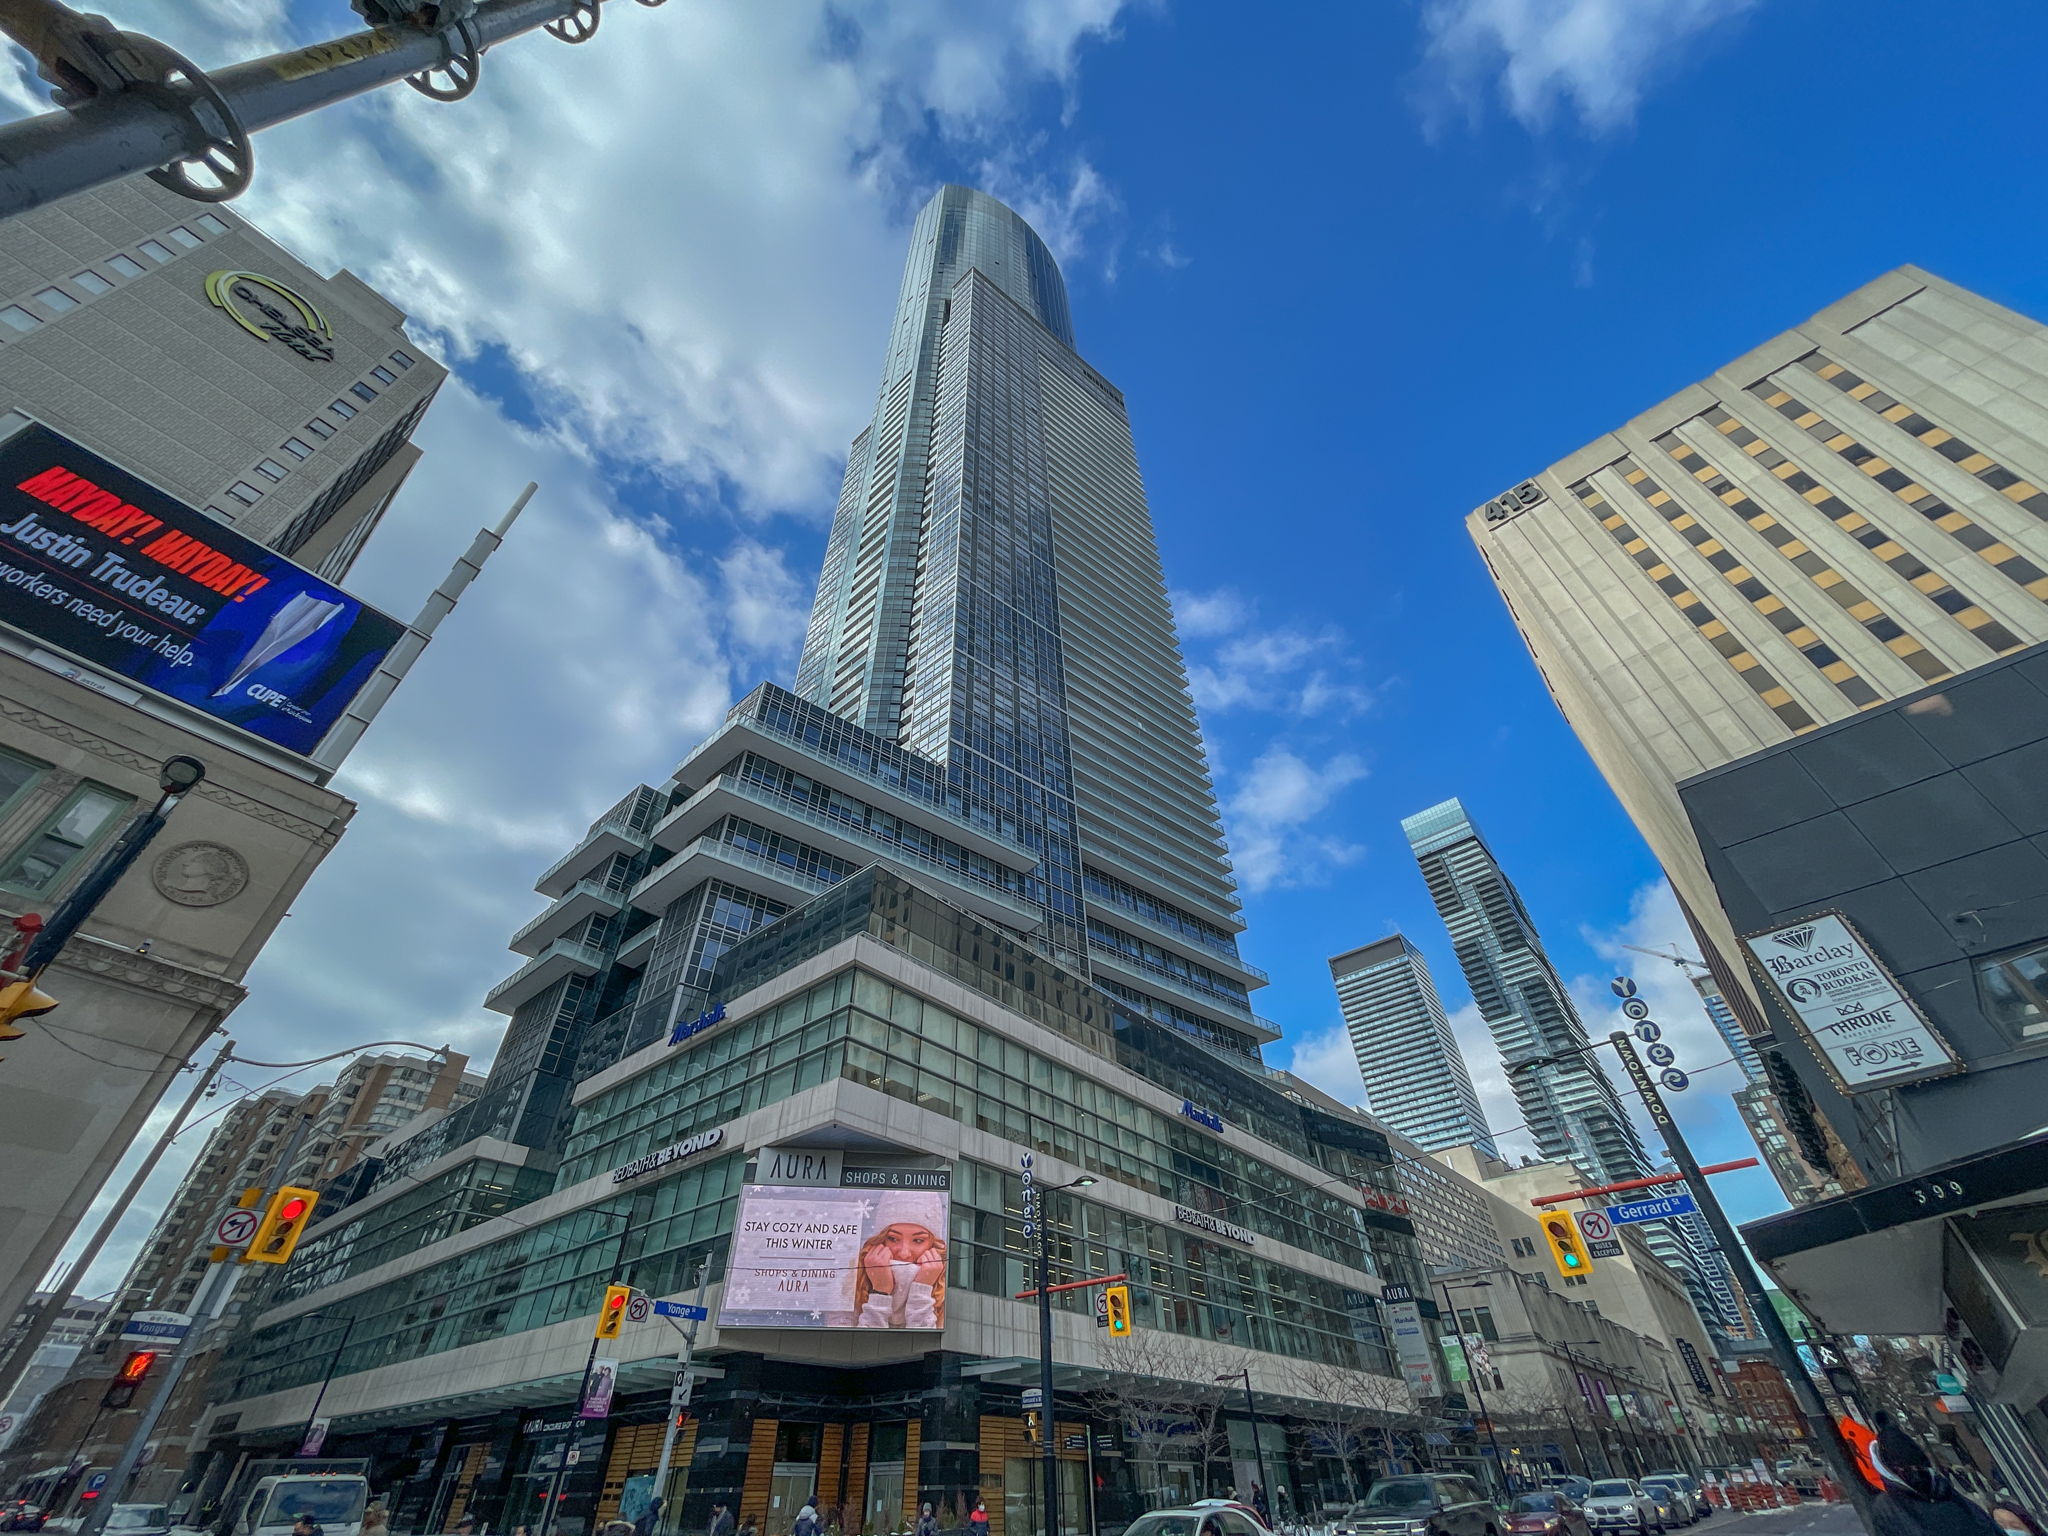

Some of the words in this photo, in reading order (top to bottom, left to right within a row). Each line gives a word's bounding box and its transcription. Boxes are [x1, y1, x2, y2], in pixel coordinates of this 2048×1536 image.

[233, 286, 335, 361] CHELSEA
[259, 321, 331, 362] Hotel
[1484, 480, 1544, 522] 415
[15, 465, 164, 545] MAYDAY!
[139, 529, 270, 604] MAYDAY!
[1, 512, 94, 569] Justin
[90, 551, 206, 626] Trudeau:
[0, 561, 70, 606] workers
[65, 596, 123, 628] need
[106, 621, 158, 647] your
[152, 633, 195, 668] help.
[246, 683, 287, 708] CUPE
[1765, 942, 1855, 979] Barclay
[1814, 960, 1870, 982] TORONTO
[1821, 969, 1878, 991] BUDOKAN
[1610, 976, 1690, 1092] Yonge
[1829, 1010, 1896, 1036] THRONE
[1844, 1037, 1922, 1067] FONE
[1615, 1038, 1669, 1125] DOWNTOWN
[1180, 1099, 1225, 1134] Marshalls
[656, 1128, 723, 1166] BEYOND
[769, 1153, 828, 1181] AURA
[845, 1171, 886, 1185] SHOPS
[891, 1173, 899, 1185] &
[904, 1174, 946, 1187] DINING
[1021, 1152, 1035, 1239] Yonge
[1914, 1180, 1962, 1204] 399
[1618, 1199, 1672, 1219] Gerrard
[1671, 1198, 1680, 1206] St
[744, 1221, 770, 1232] STAY
[772, 1222, 803, 1233] COZY
[804, 1223, 830, 1234] AND
[832, 1224, 858, 1235] SAFE
[1215, 1219, 1257, 1245] BEYOND
[766, 1238, 789, 1249] THIS
[792, 1239, 833, 1250] WINTER
[1593, 1248, 1621, 1257] EXCEPTED
[1594, 1241, 1613, 1250] BUSES
[754, 1269, 788, 1278] SHOPS
[792, 1269, 798, 1278] &
[801, 1269, 836, 1279] DINING
[777, 1280, 810, 1293] AURA
[1386, 1286, 1410, 1300] AURA
[667, 1303, 691, 1318] Yonge
[137, 1322, 166, 1336] Yonge
